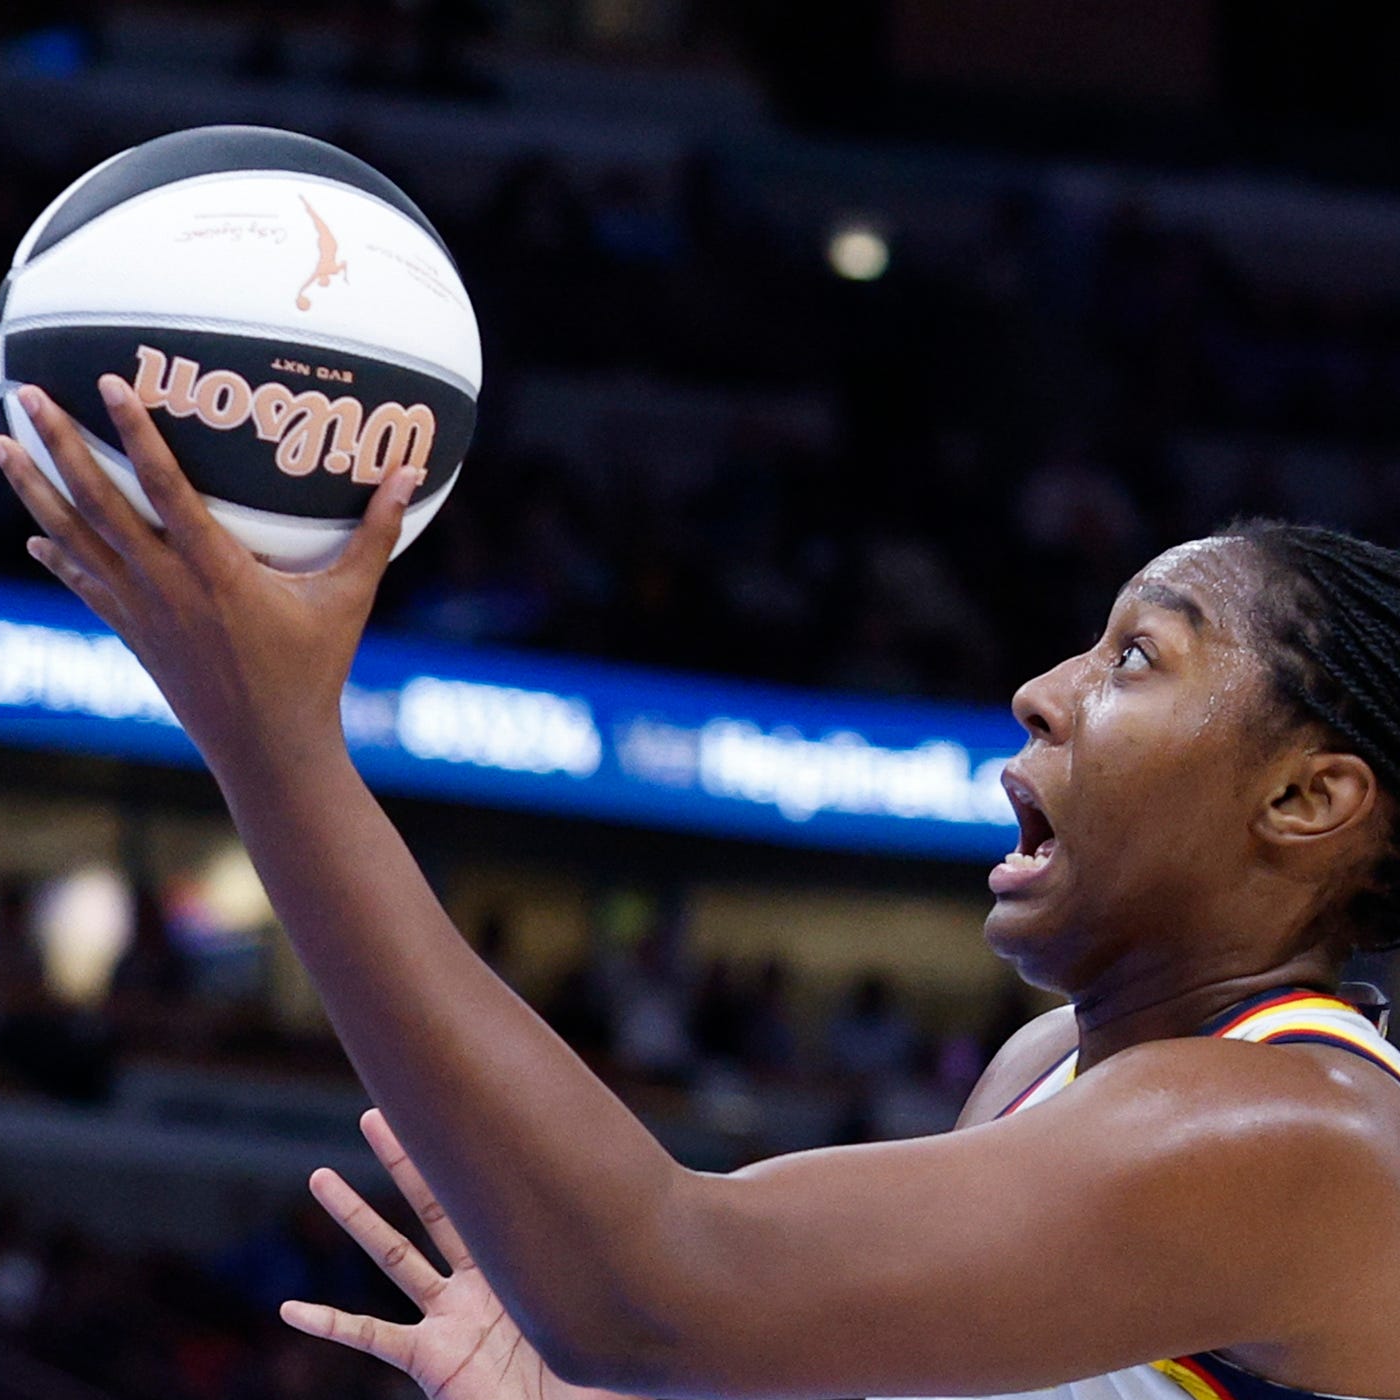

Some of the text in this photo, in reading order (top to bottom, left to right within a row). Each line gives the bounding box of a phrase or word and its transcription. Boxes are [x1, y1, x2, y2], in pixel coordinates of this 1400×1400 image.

[271, 358, 353, 384] EVO NXT
[134, 344, 436, 486] Wilson
